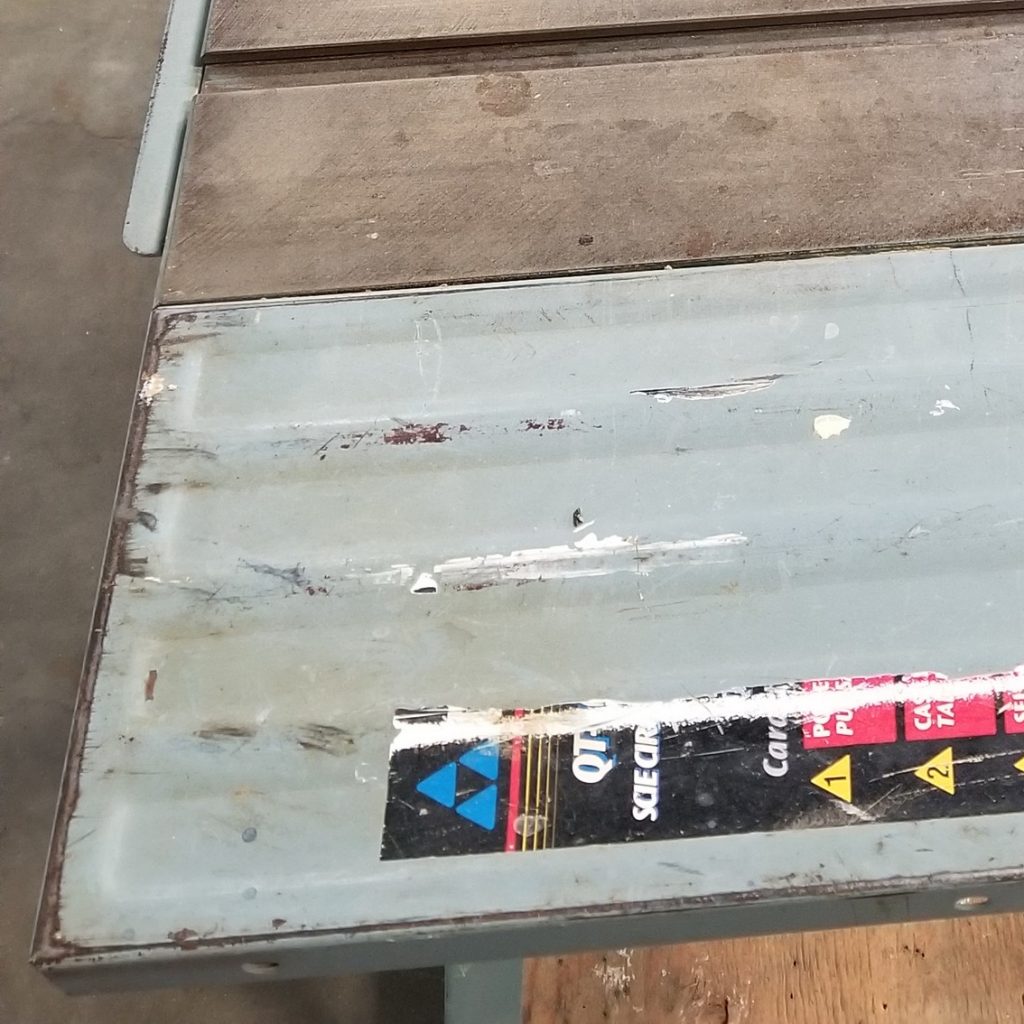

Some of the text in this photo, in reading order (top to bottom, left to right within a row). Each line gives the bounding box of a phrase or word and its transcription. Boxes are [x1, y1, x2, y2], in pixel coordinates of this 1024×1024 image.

[824, 773, 847, 787] 1
[926, 767, 950, 780] 2
[631, 768, 661, 823] SCIE
